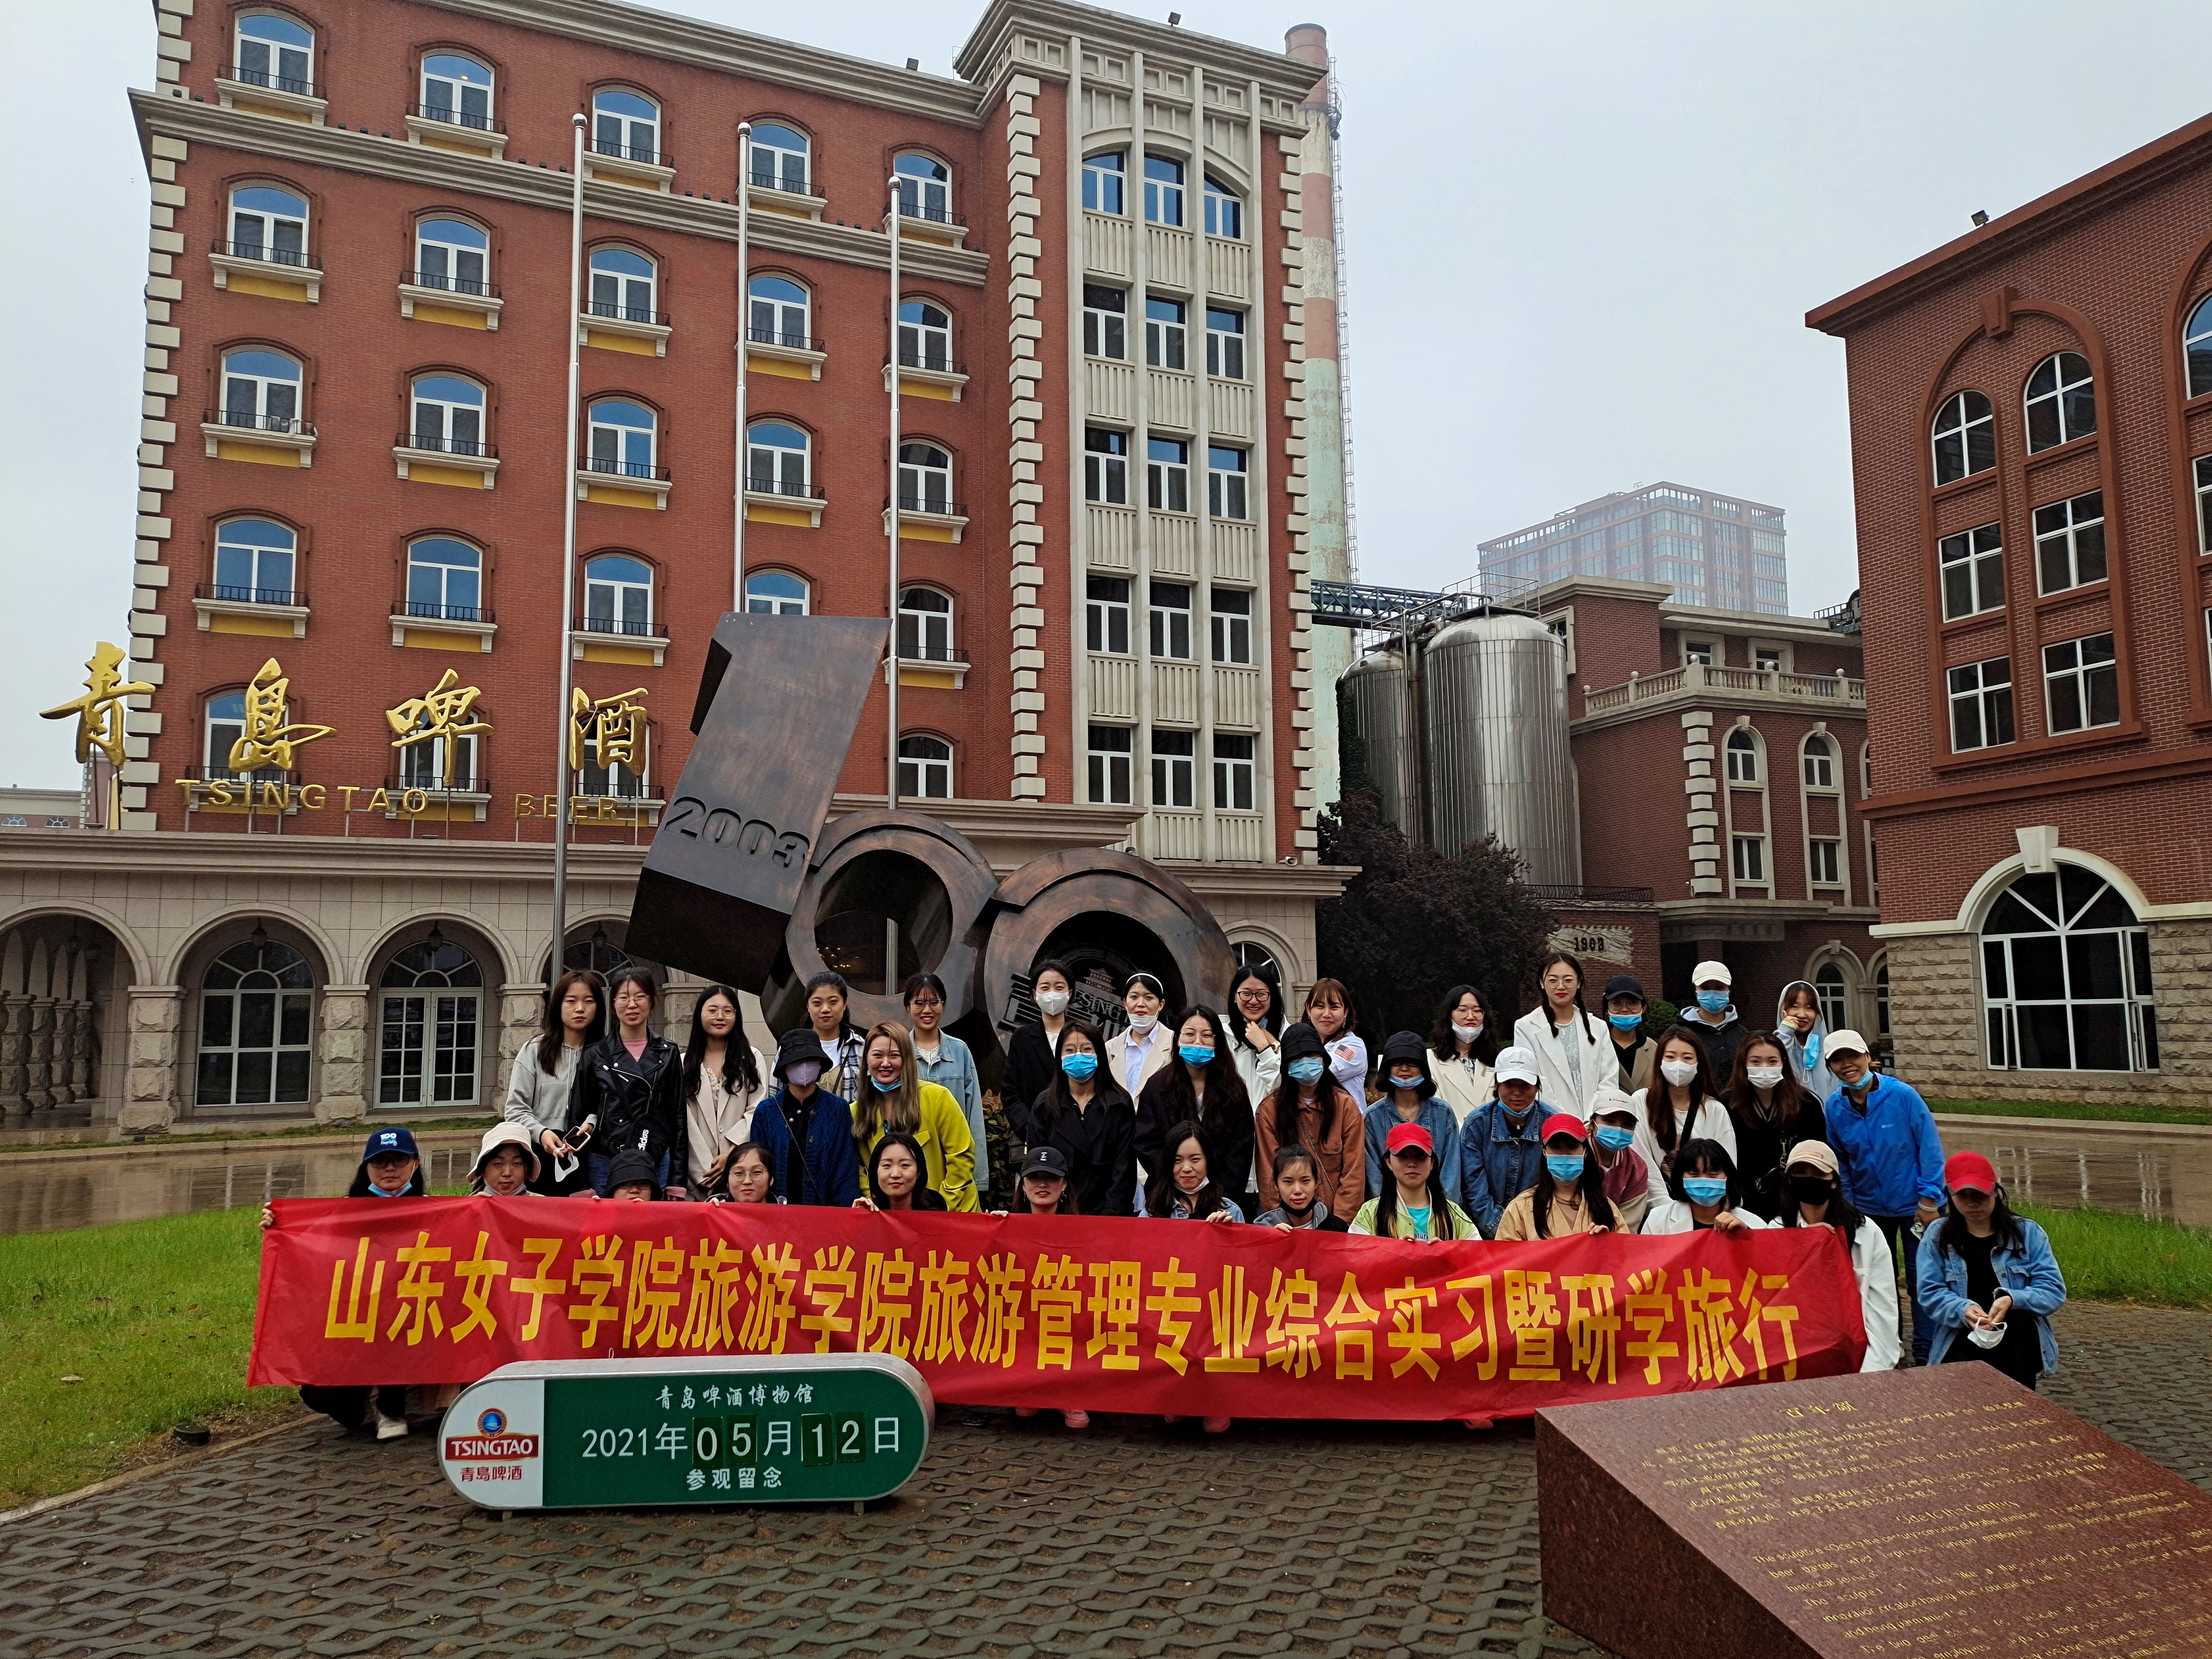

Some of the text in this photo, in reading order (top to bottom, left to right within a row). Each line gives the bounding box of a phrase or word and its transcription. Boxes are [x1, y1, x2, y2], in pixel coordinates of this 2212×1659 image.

[175, 778, 618, 821] TSINGTAO BEER
[663, 796, 811, 869] 2003
[324, 1230, 1800, 1384] 山东女子学院旅游学院旅游管理专业综合实习暨研学旅行
[451, 1438, 533, 1456] TSINGTAO
[686, 1466, 782, 1491] 参观留念
[1970, 1500, 2020, 1513] Century
[1769, 1569, 1795, 1578] beer
[2043, 1523, 2074, 1531] strong
[1889, 1639, 1911, 1648] two
